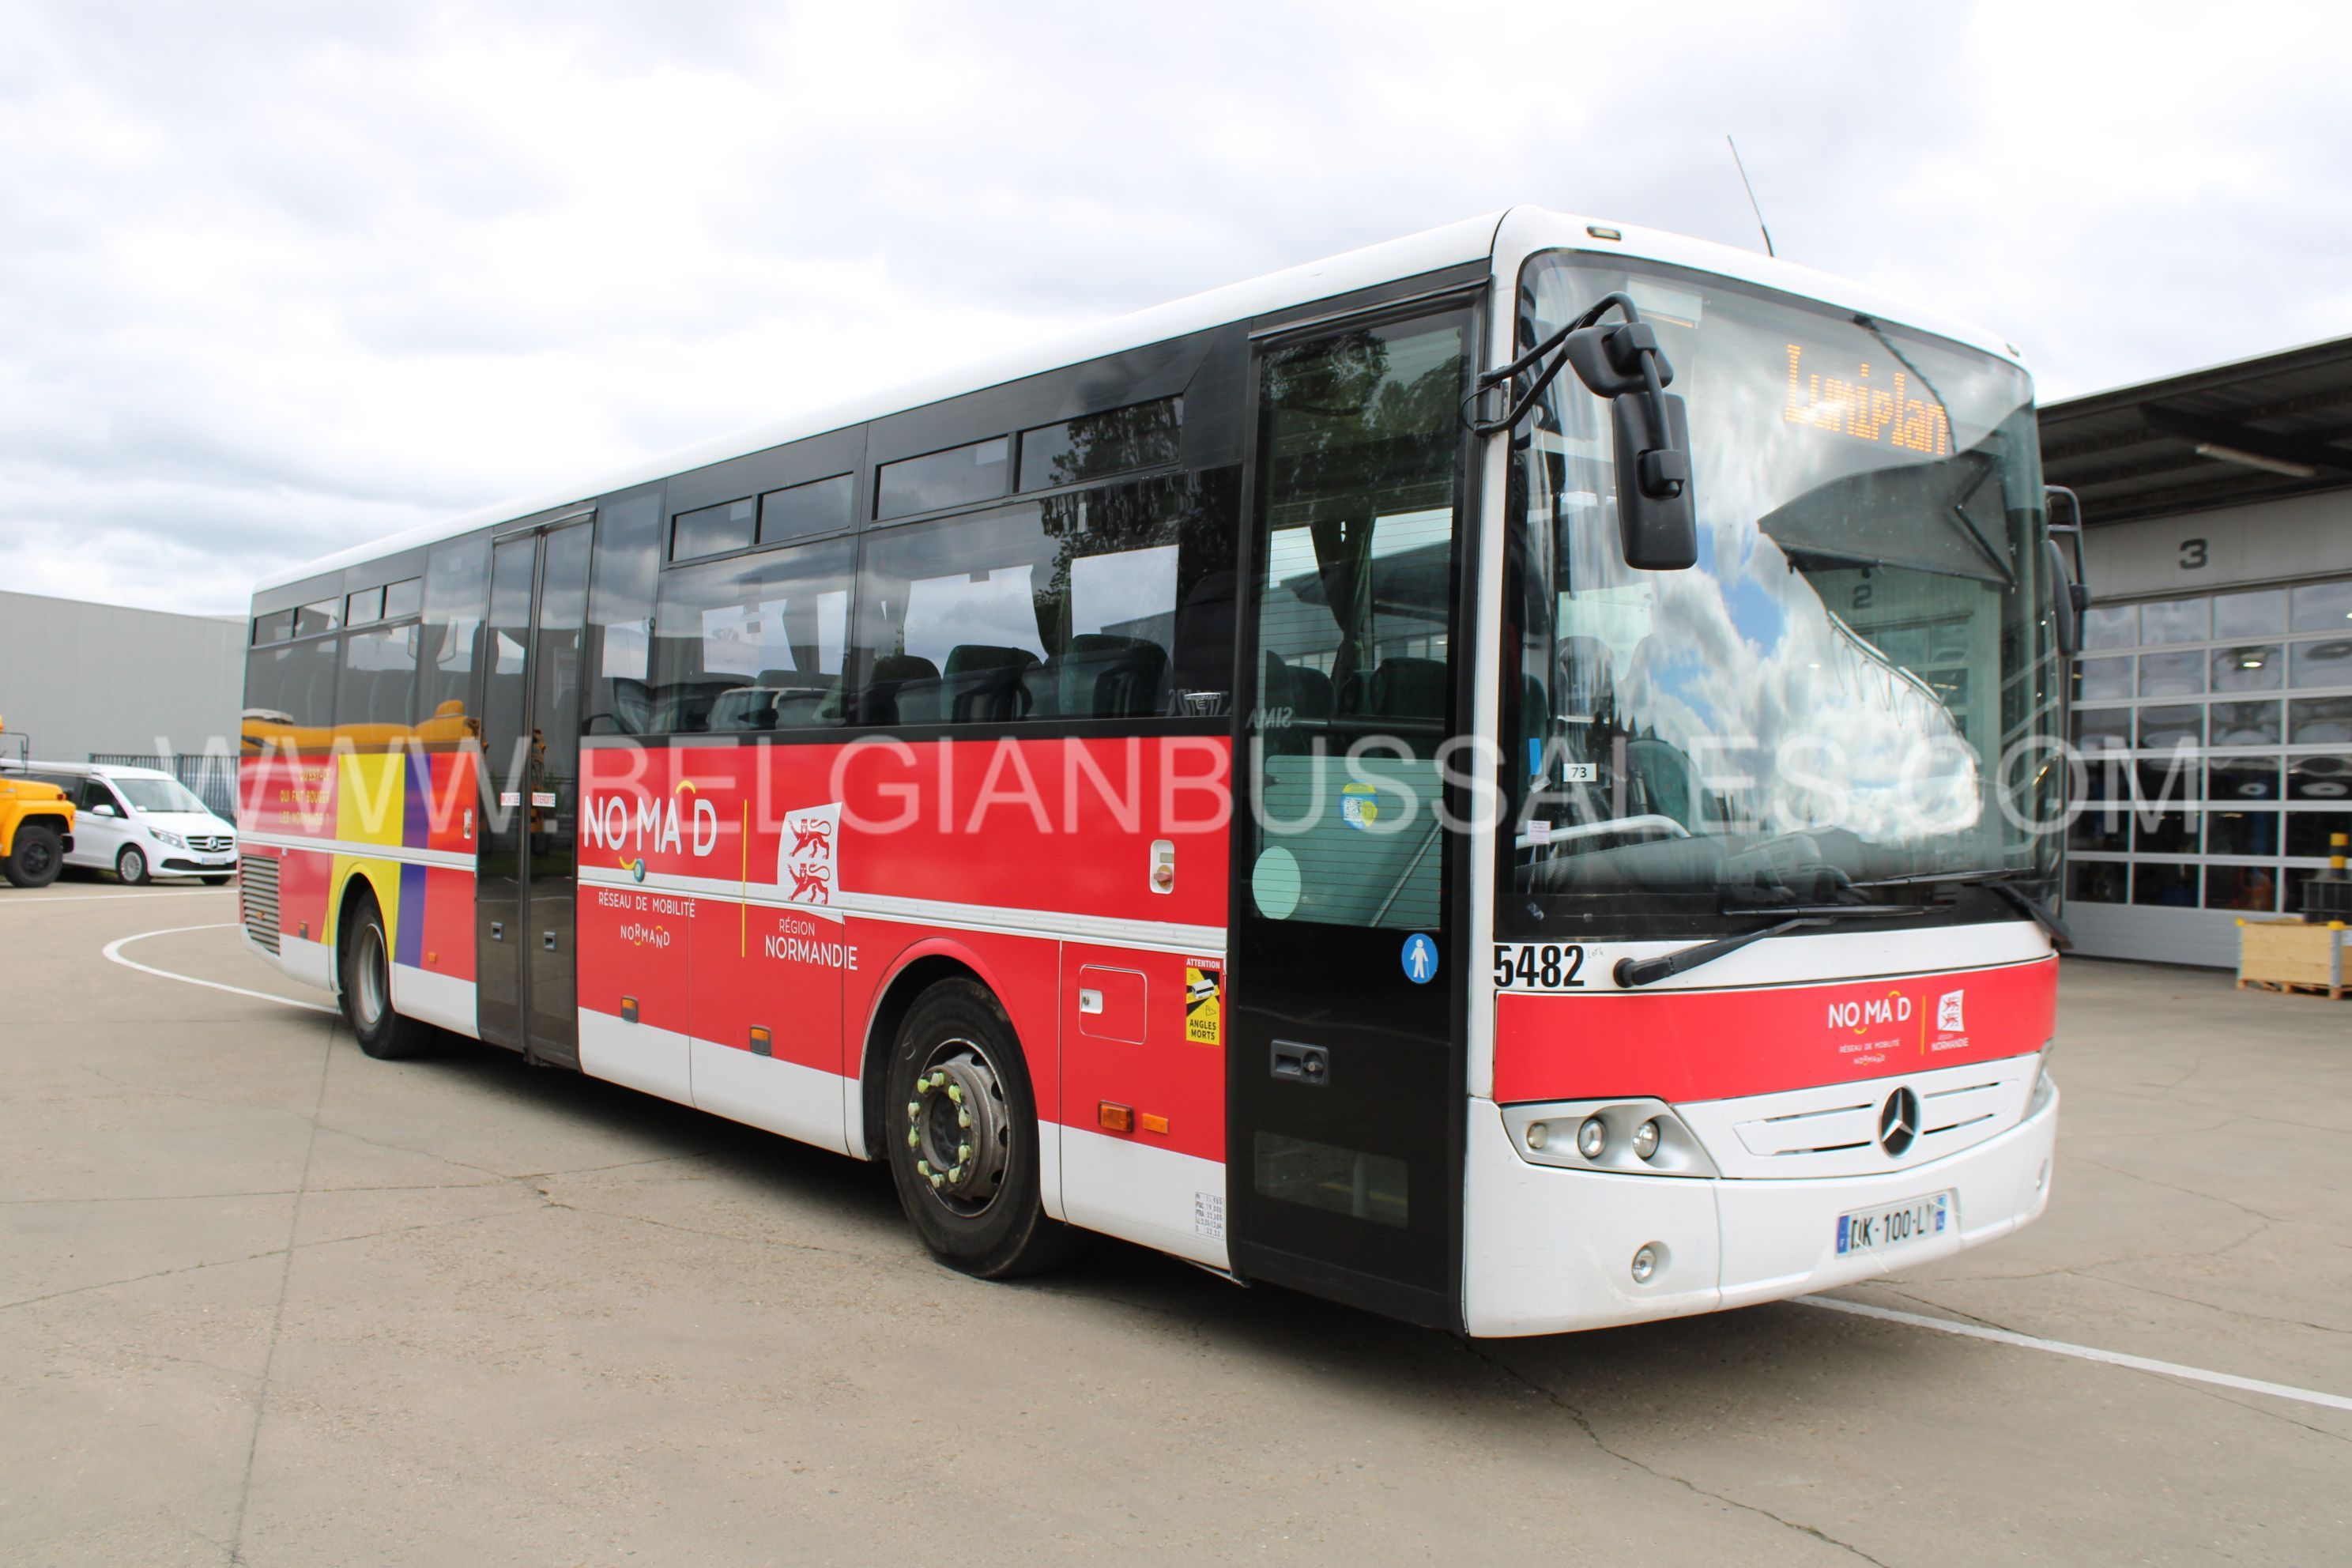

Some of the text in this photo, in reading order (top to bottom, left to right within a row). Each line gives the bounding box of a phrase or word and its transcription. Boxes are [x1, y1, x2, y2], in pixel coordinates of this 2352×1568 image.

[2179, 538, 2207, 570] 3
[1853, 584, 1872, 609] 2
[1571, 767, 1587, 778] 73
[584, 795, 717, 857] NOMAD
[598, 888, 695, 918] RÉSEAU DE MOBILITÉ
[620, 923, 670, 948] NORMAND
[778, 916, 816, 936] RÉGION
[765, 934, 858, 971] NORMANDIE
[1186, 958, 1220, 969] ATTENTION
[1493, 944, 1585, 987] 5482
[1189, 1019, 1216, 1031] ANGLES
[1828, 997, 1912, 1029] NOMAD
[1191, 1029, 1216, 1040] MORTS
